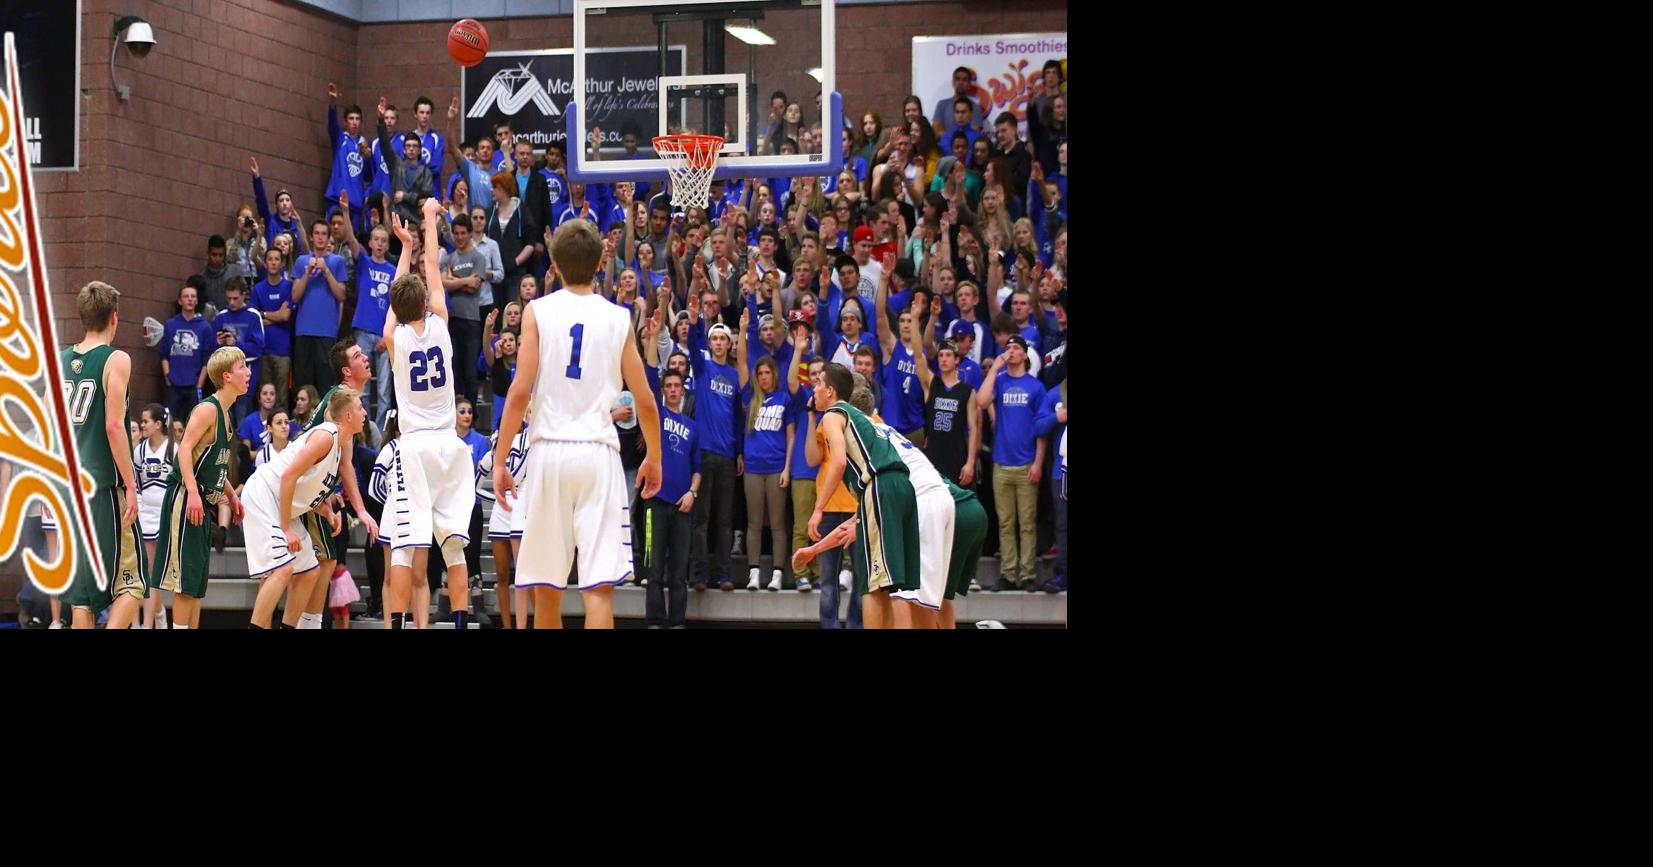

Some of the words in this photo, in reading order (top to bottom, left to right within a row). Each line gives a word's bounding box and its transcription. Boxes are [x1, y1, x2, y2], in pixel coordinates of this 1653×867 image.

[946, 43, 990, 56] Drinks
[547, 77, 614, 95] Mcthur
[565, 323, 585, 380] 1
[409, 345, 447, 392] 23
[897, 359, 916, 375] DIXI
[710, 379, 733, 396] DIXIE
[902, 376, 911, 394] 4
[934, 397, 959, 412] DIXIE
[1002, 392, 1028, 405] DIXIE
[758, 404, 785, 418] OMB
[663, 416, 690, 441] DIXIE
[754, 417, 782, 431] QUAD
[934, 411, 953, 432] 25
[395, 449, 406, 492] FLYERS
